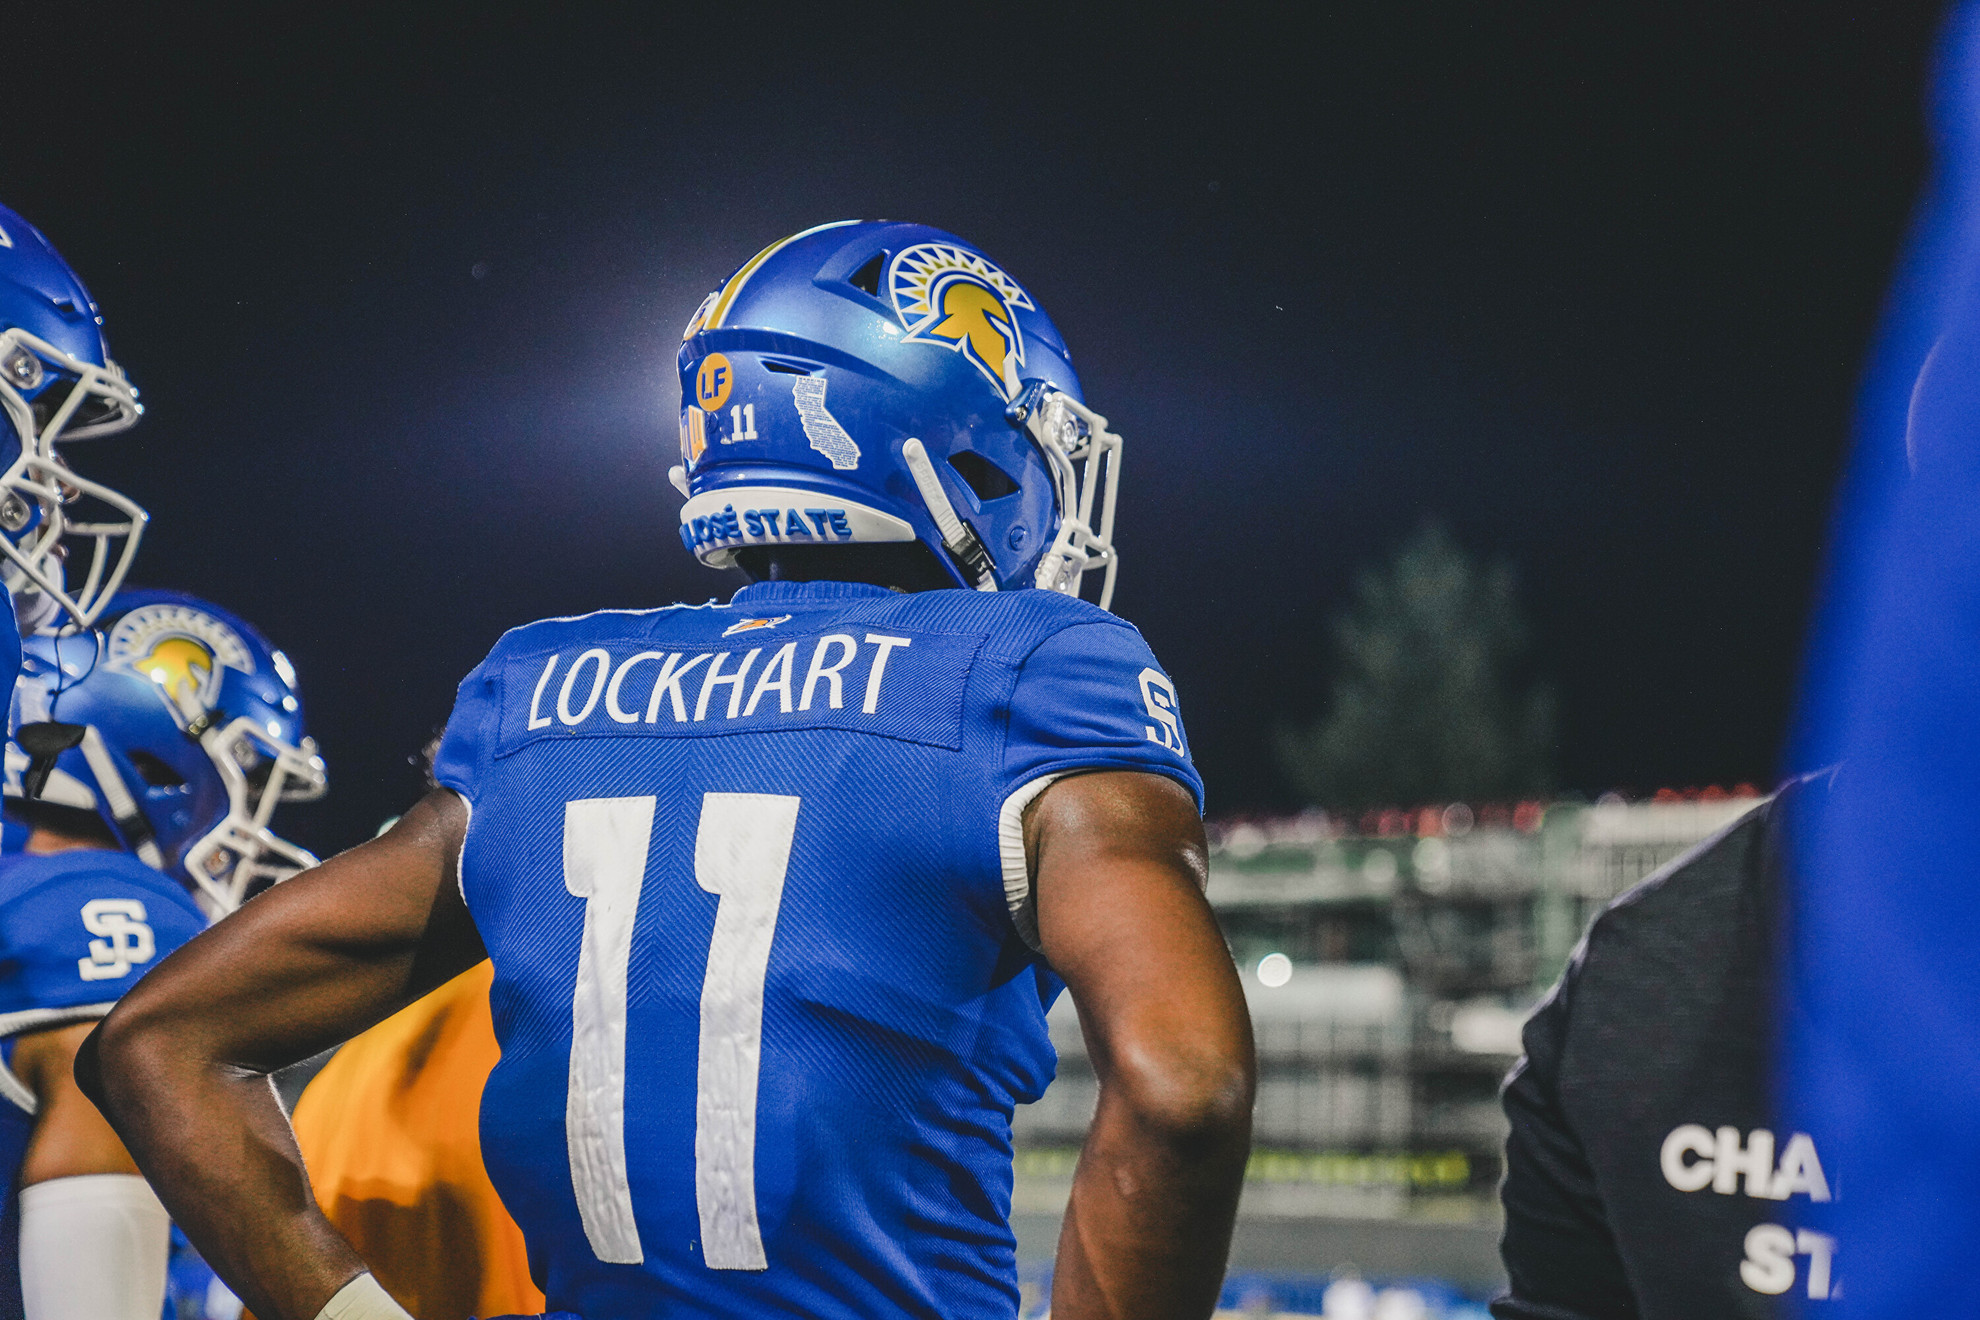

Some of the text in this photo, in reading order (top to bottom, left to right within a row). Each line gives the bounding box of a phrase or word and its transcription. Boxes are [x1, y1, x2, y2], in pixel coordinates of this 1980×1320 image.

[701, 366, 727, 400] LF
[730, 403, 758, 442] 11
[743, 508, 853, 538] STATE
[527, 633, 912, 731] LOCKHART
[563, 792, 801, 1271] 11
[1660, 1123, 1838, 1203] CHA
[1739, 1223, 1840, 1301] ST
